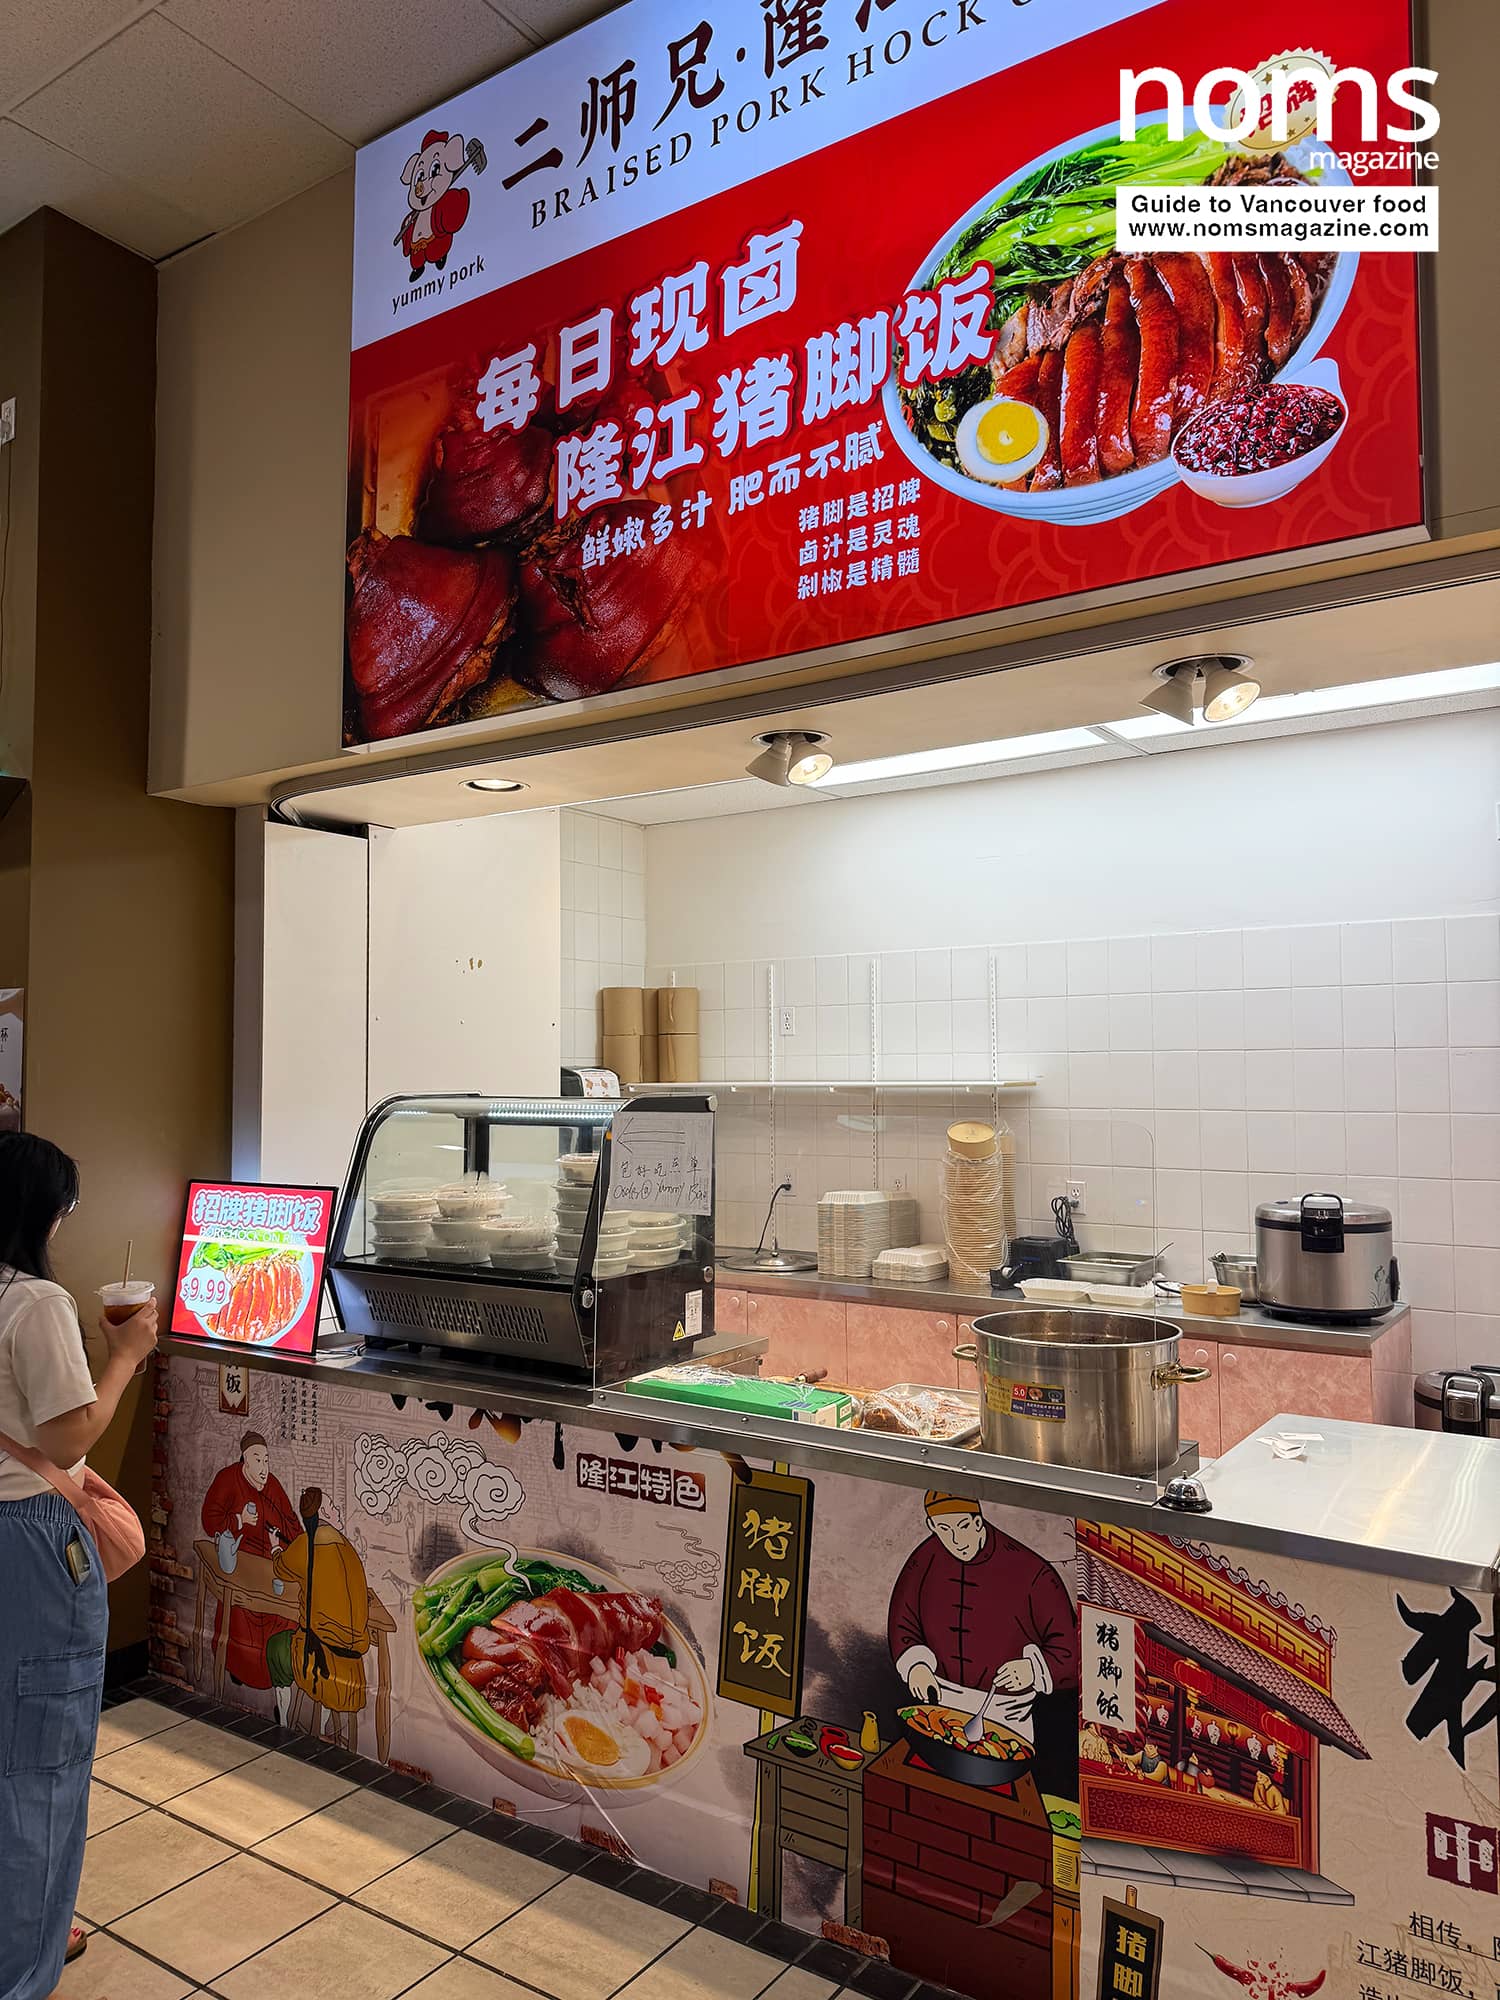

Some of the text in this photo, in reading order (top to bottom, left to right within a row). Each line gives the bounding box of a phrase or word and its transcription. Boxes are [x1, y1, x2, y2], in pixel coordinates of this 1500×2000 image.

[501, 0, 897, 190] 二师兄·隆
[531, 0, 987, 229] BRAISED PORK HOCK
[391, 254, 486, 315] yummy pork
[475, 219, 804, 434] 每日现卤
[554, 265, 996, 518] 隆江猪脚饭
[581, 419, 885, 570] 鲜嫩多汁 肥而不腻
[798, 477, 921, 533] 猪脚是招牌
[797, 547, 921, 601] 剁椒是精髓
[798, 513, 921, 567] 卤汁是灵魂
[193, 1191, 323, 1234] 招牌猪脚饭
[182, 1276, 226, 1302] $9.99
[579, 1456, 706, 1508] 隆江特色
[733, 1508, 795, 1679] 猪脚饭
[1095, 1622, 1124, 1722] 猪脚饭
[1111, 1925, 1148, 2000] 猪脚
[1356, 1938, 1500, 2000] 江猪脚饭，
